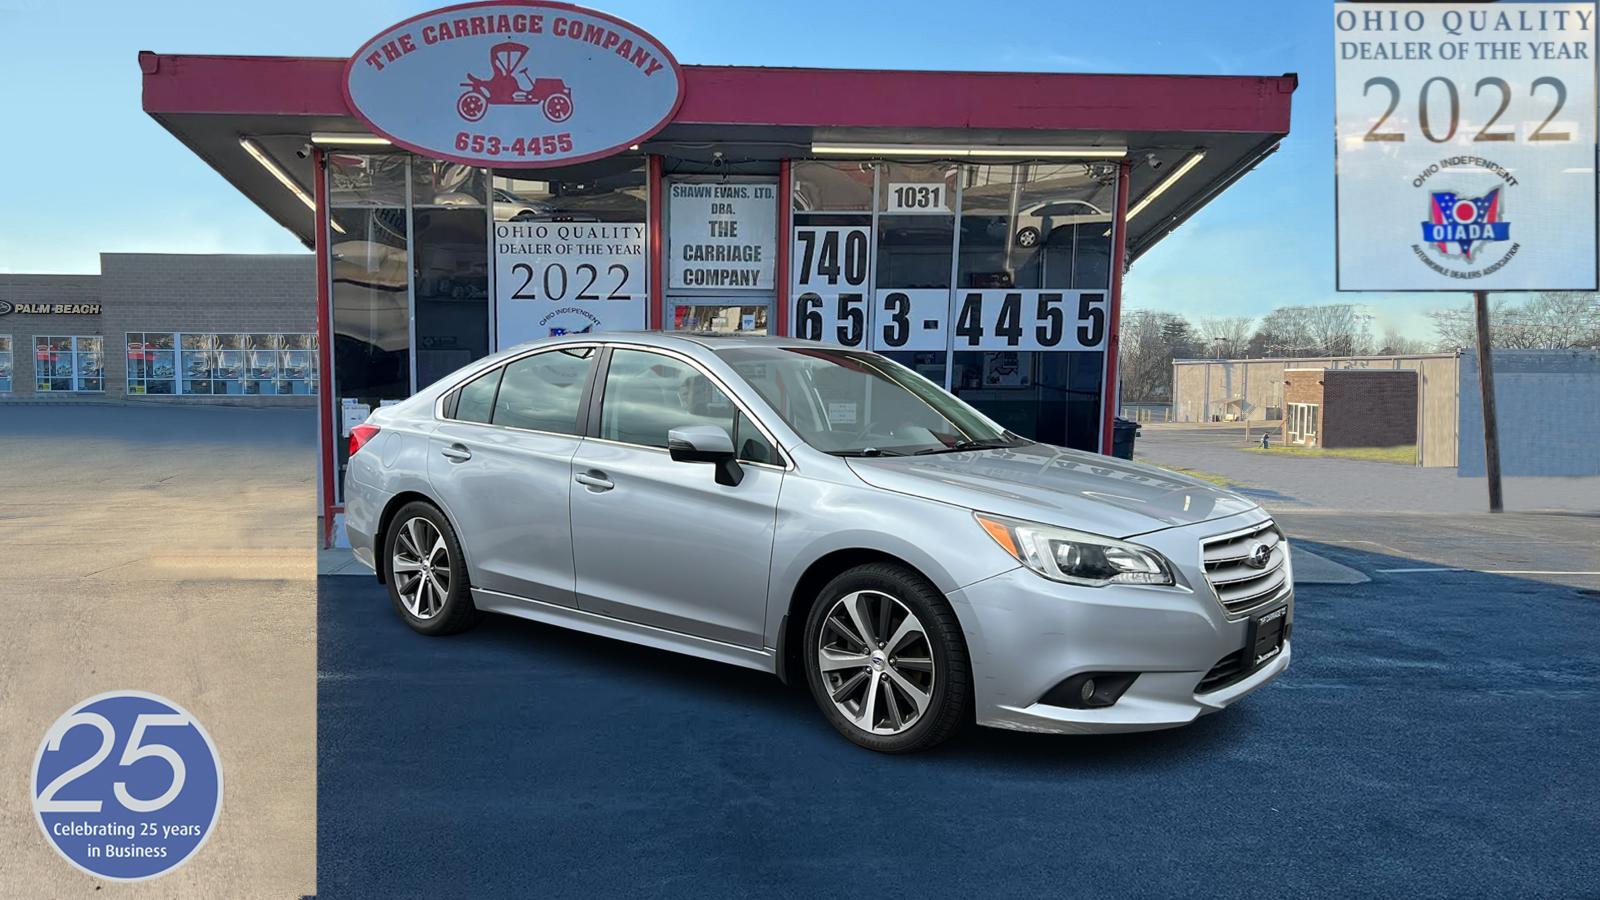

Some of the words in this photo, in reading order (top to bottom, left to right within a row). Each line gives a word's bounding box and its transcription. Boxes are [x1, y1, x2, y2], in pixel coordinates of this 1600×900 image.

[1336, 10, 1425, 31] OHIO
[1442, 10, 1593, 35] QUALITY
[366, 33, 416, 72] THE
[422, 14, 543, 45] CARRIAGE
[553, 16, 664, 77] COMPANY
[1340, 41, 1433, 60] DEALER
[1439, 41, 1469, 60] OF
[1475, 41, 1522, 60] THE
[1528, 41, 1589, 60] YEAR
[1362, 76, 1571, 143] 2022
[455, 131, 573, 156] 653-4455
[1413, 164, 1439, 188] OHIO
[1440, 155, 1519, 187] INDEPENDENT
[673, 185, 712, 198] SHAWN
[754, 186, 775, 199] LTD.
[895, 187, 940, 208] 1031
[711, 203, 736, 215] DBA.
[497, 225, 548, 239] OHIO
[557, 225, 644, 241] QUALITY
[708, 220, 738, 238] THE
[1432, 224, 1495, 240] OIADA
[500, 243, 552, 255] DEALER
[555, 243, 574, 255] OF
[576, 243, 603, 255] THE
[606, 243, 642, 255] YEAR
[683, 244, 762, 262] CARRIAGE
[797, 230, 868, 286] 740
[1411, 243, 1450, 277] AUTOMOBILE
[1449, 270, 1483, 279] DEALERS
[1482, 242, 1521, 277] ASSOCIATION
[511, 262, 632, 301] 2022
[683, 268, 760, 286] COMPANY
[14, 303, 51, 314] PALM
[54, 303, 100, 315] BEACH
[539, 312, 556, 326] OHIO
[555, 307, 601, 326] INDEPENDENT
